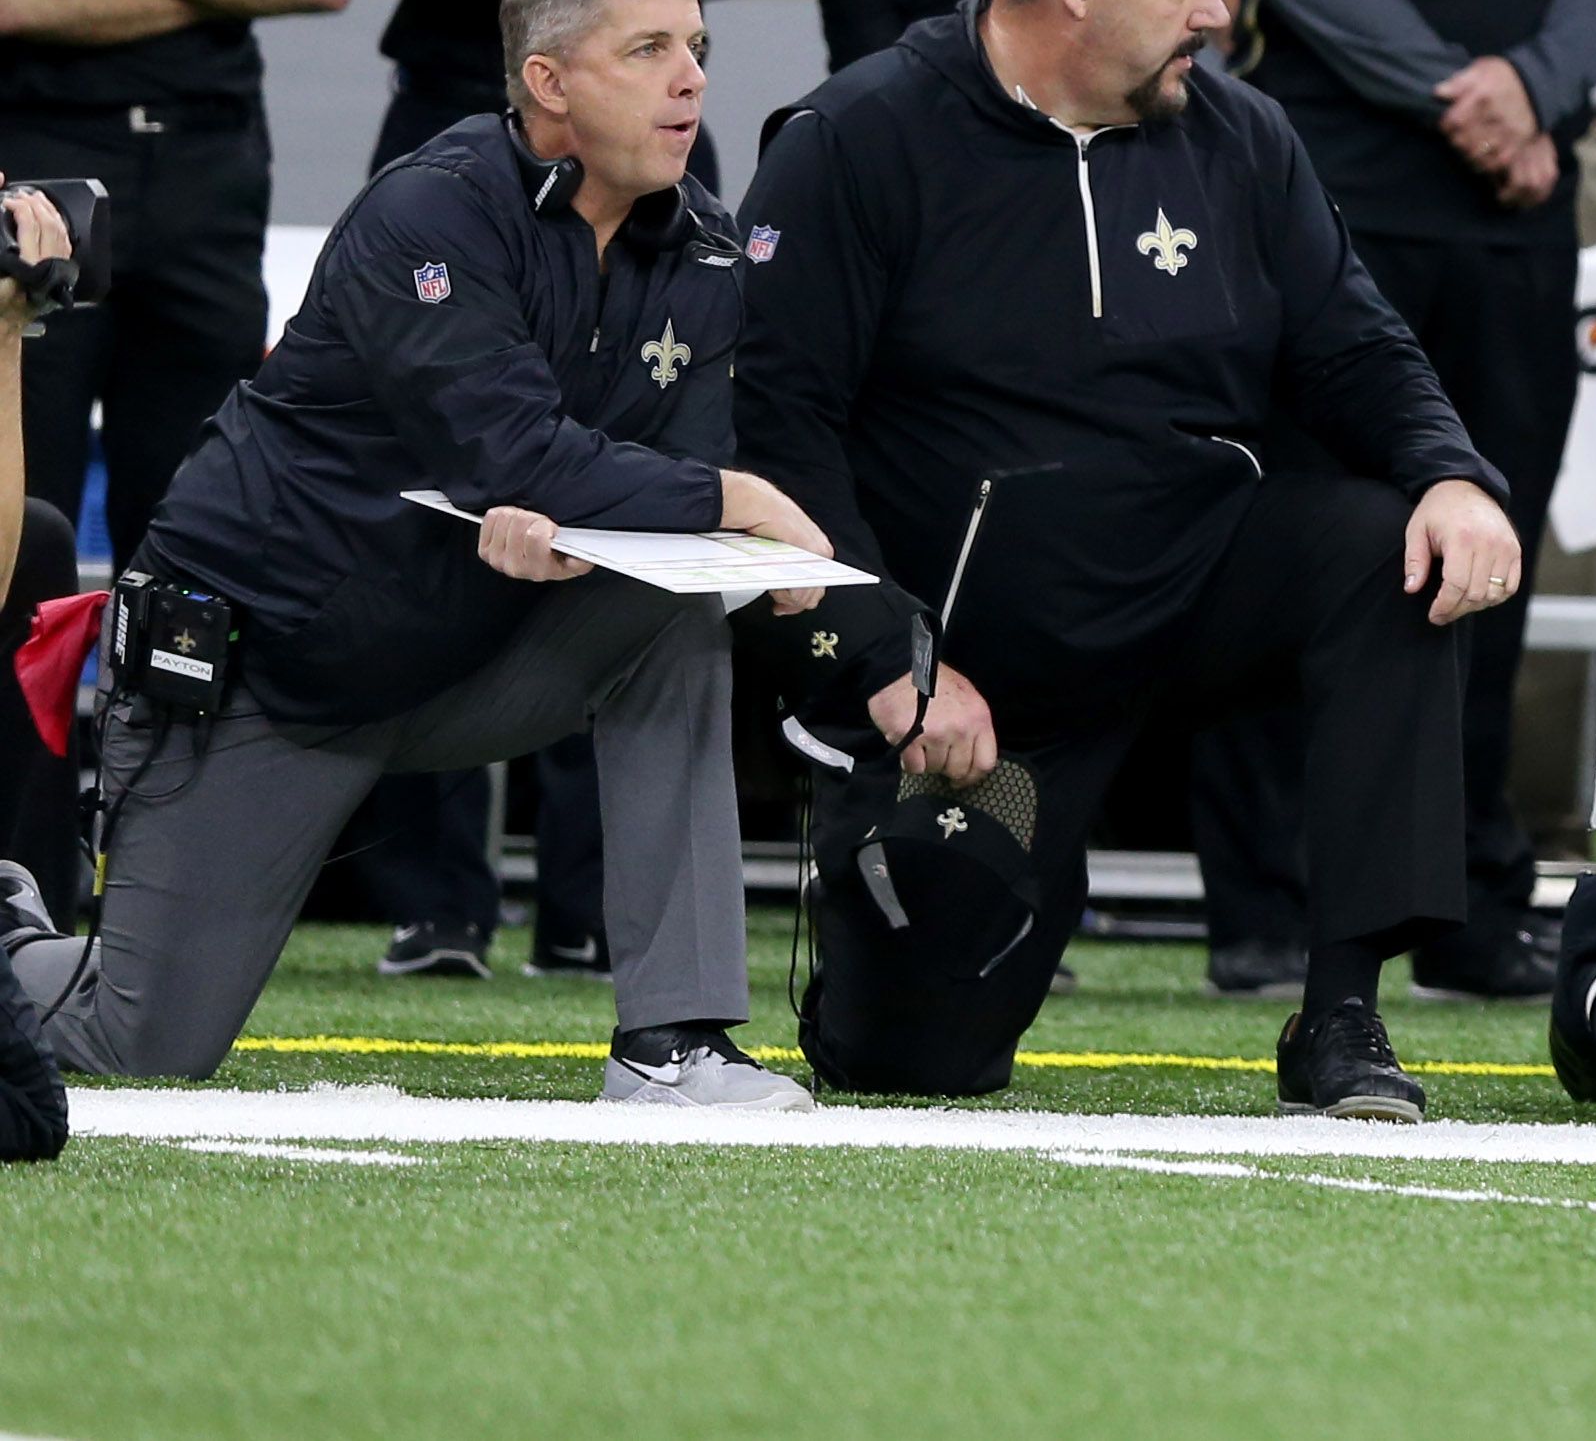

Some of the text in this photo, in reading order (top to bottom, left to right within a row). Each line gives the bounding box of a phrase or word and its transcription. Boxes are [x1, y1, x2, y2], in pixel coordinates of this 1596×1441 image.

[749, 239, 770, 258] NFL
[421, 278, 446, 299] NFL
[152, 654, 212, 677] PAYTON
